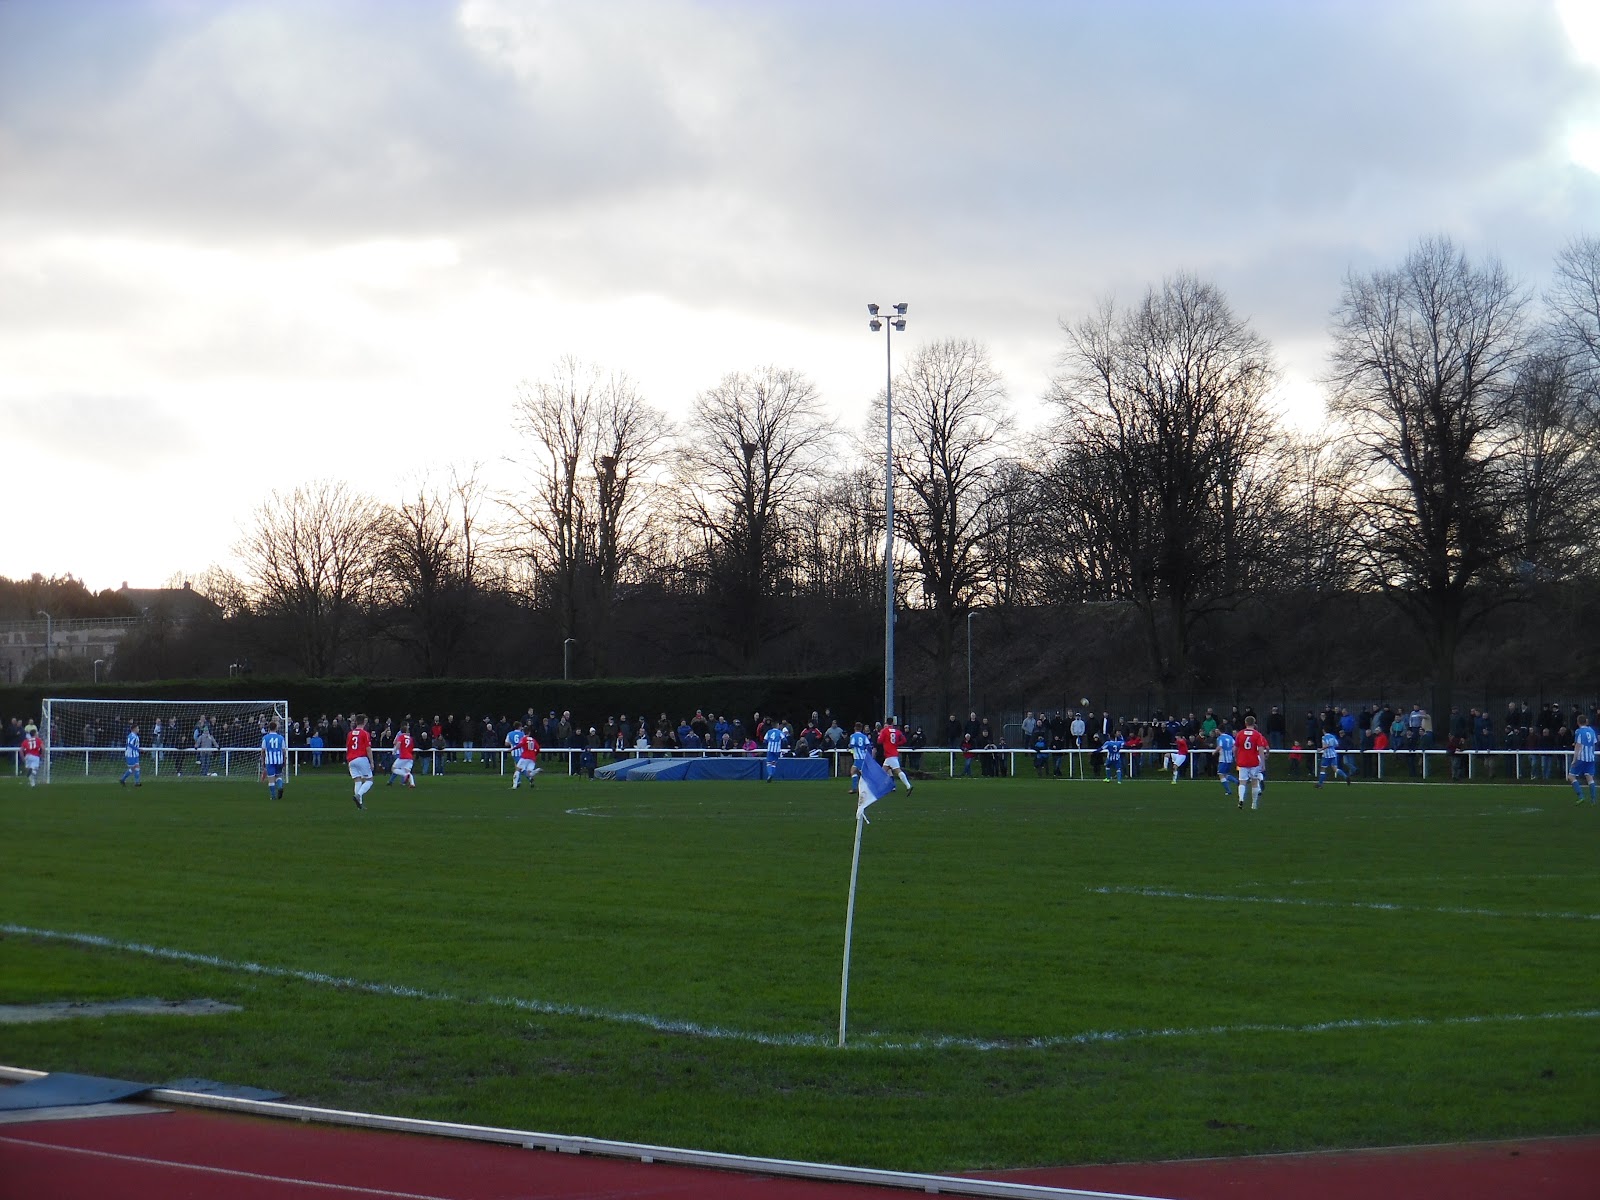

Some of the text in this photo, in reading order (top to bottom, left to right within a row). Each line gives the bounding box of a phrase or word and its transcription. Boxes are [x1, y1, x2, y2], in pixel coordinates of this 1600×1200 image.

[513, 734, 520, 744] 6
[770, 731, 776, 740] 4
[890, 732, 896, 744] 8
[1586, 731, 1592, 743] 9
[269, 737, 279, 749] 11
[351, 736, 358, 750] 3
[404, 738, 411, 748] 9
[526, 740, 535, 751] 10
[858, 736, 864, 747] 8
[1243, 736, 1252, 750] 6
[1112, 744, 1118, 752] 3
